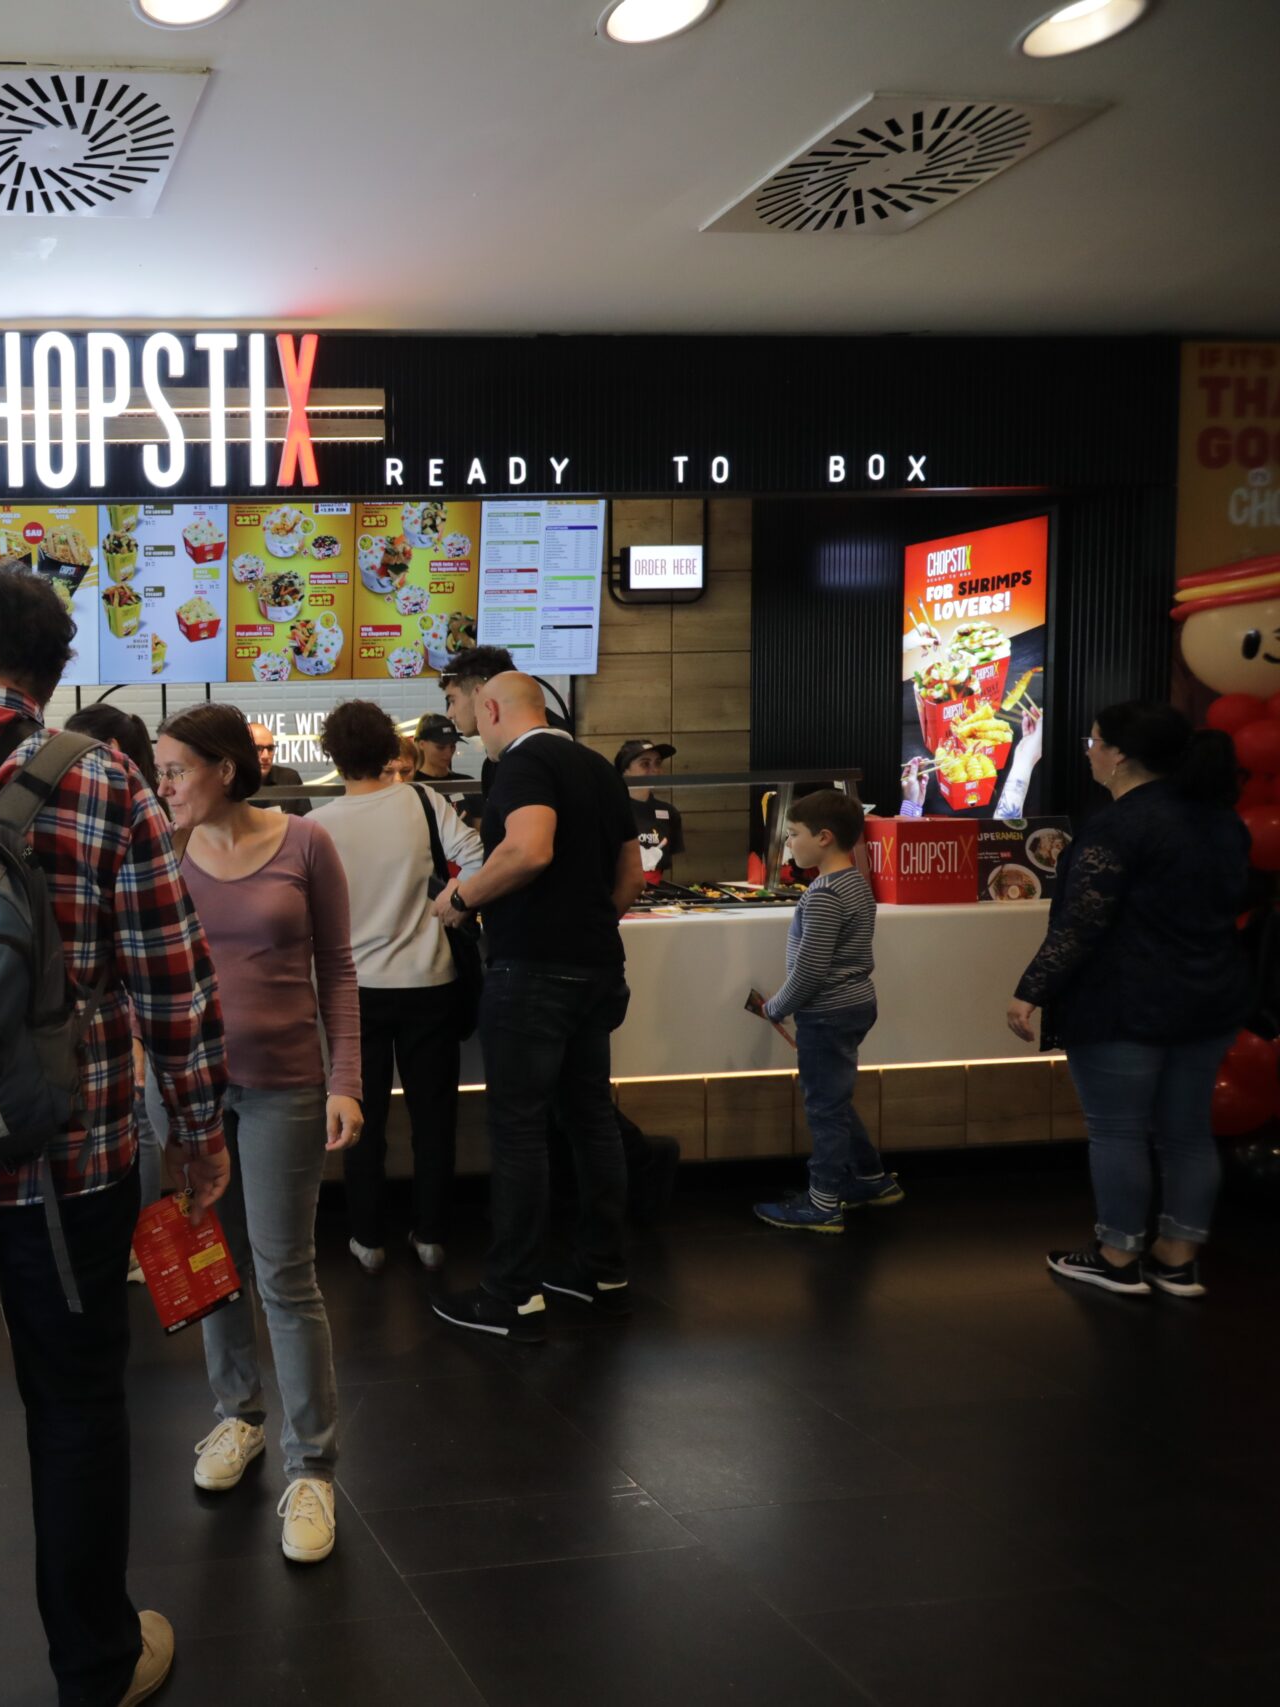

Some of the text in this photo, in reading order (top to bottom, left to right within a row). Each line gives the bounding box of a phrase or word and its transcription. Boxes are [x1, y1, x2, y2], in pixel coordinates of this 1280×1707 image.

[1199, 348, 1275, 368] IF IT'S
[385, 453, 928, 488] READY TO BOX
[363, 516, 377, 526] 23
[25, 529, 43, 537] SAU
[633, 557, 698, 578] ORDER HERE
[926, 544, 972, 577] CHOPSTIX
[430, 583, 444, 592] 24
[926, 570, 1033, 602] FOR SHRIMPS
[933, 591, 1011, 621] LOVERS!
[360, 648, 375, 657] 24
[295, 712, 332, 736] WO
[901, 835, 974, 874] CHOPSTIX
